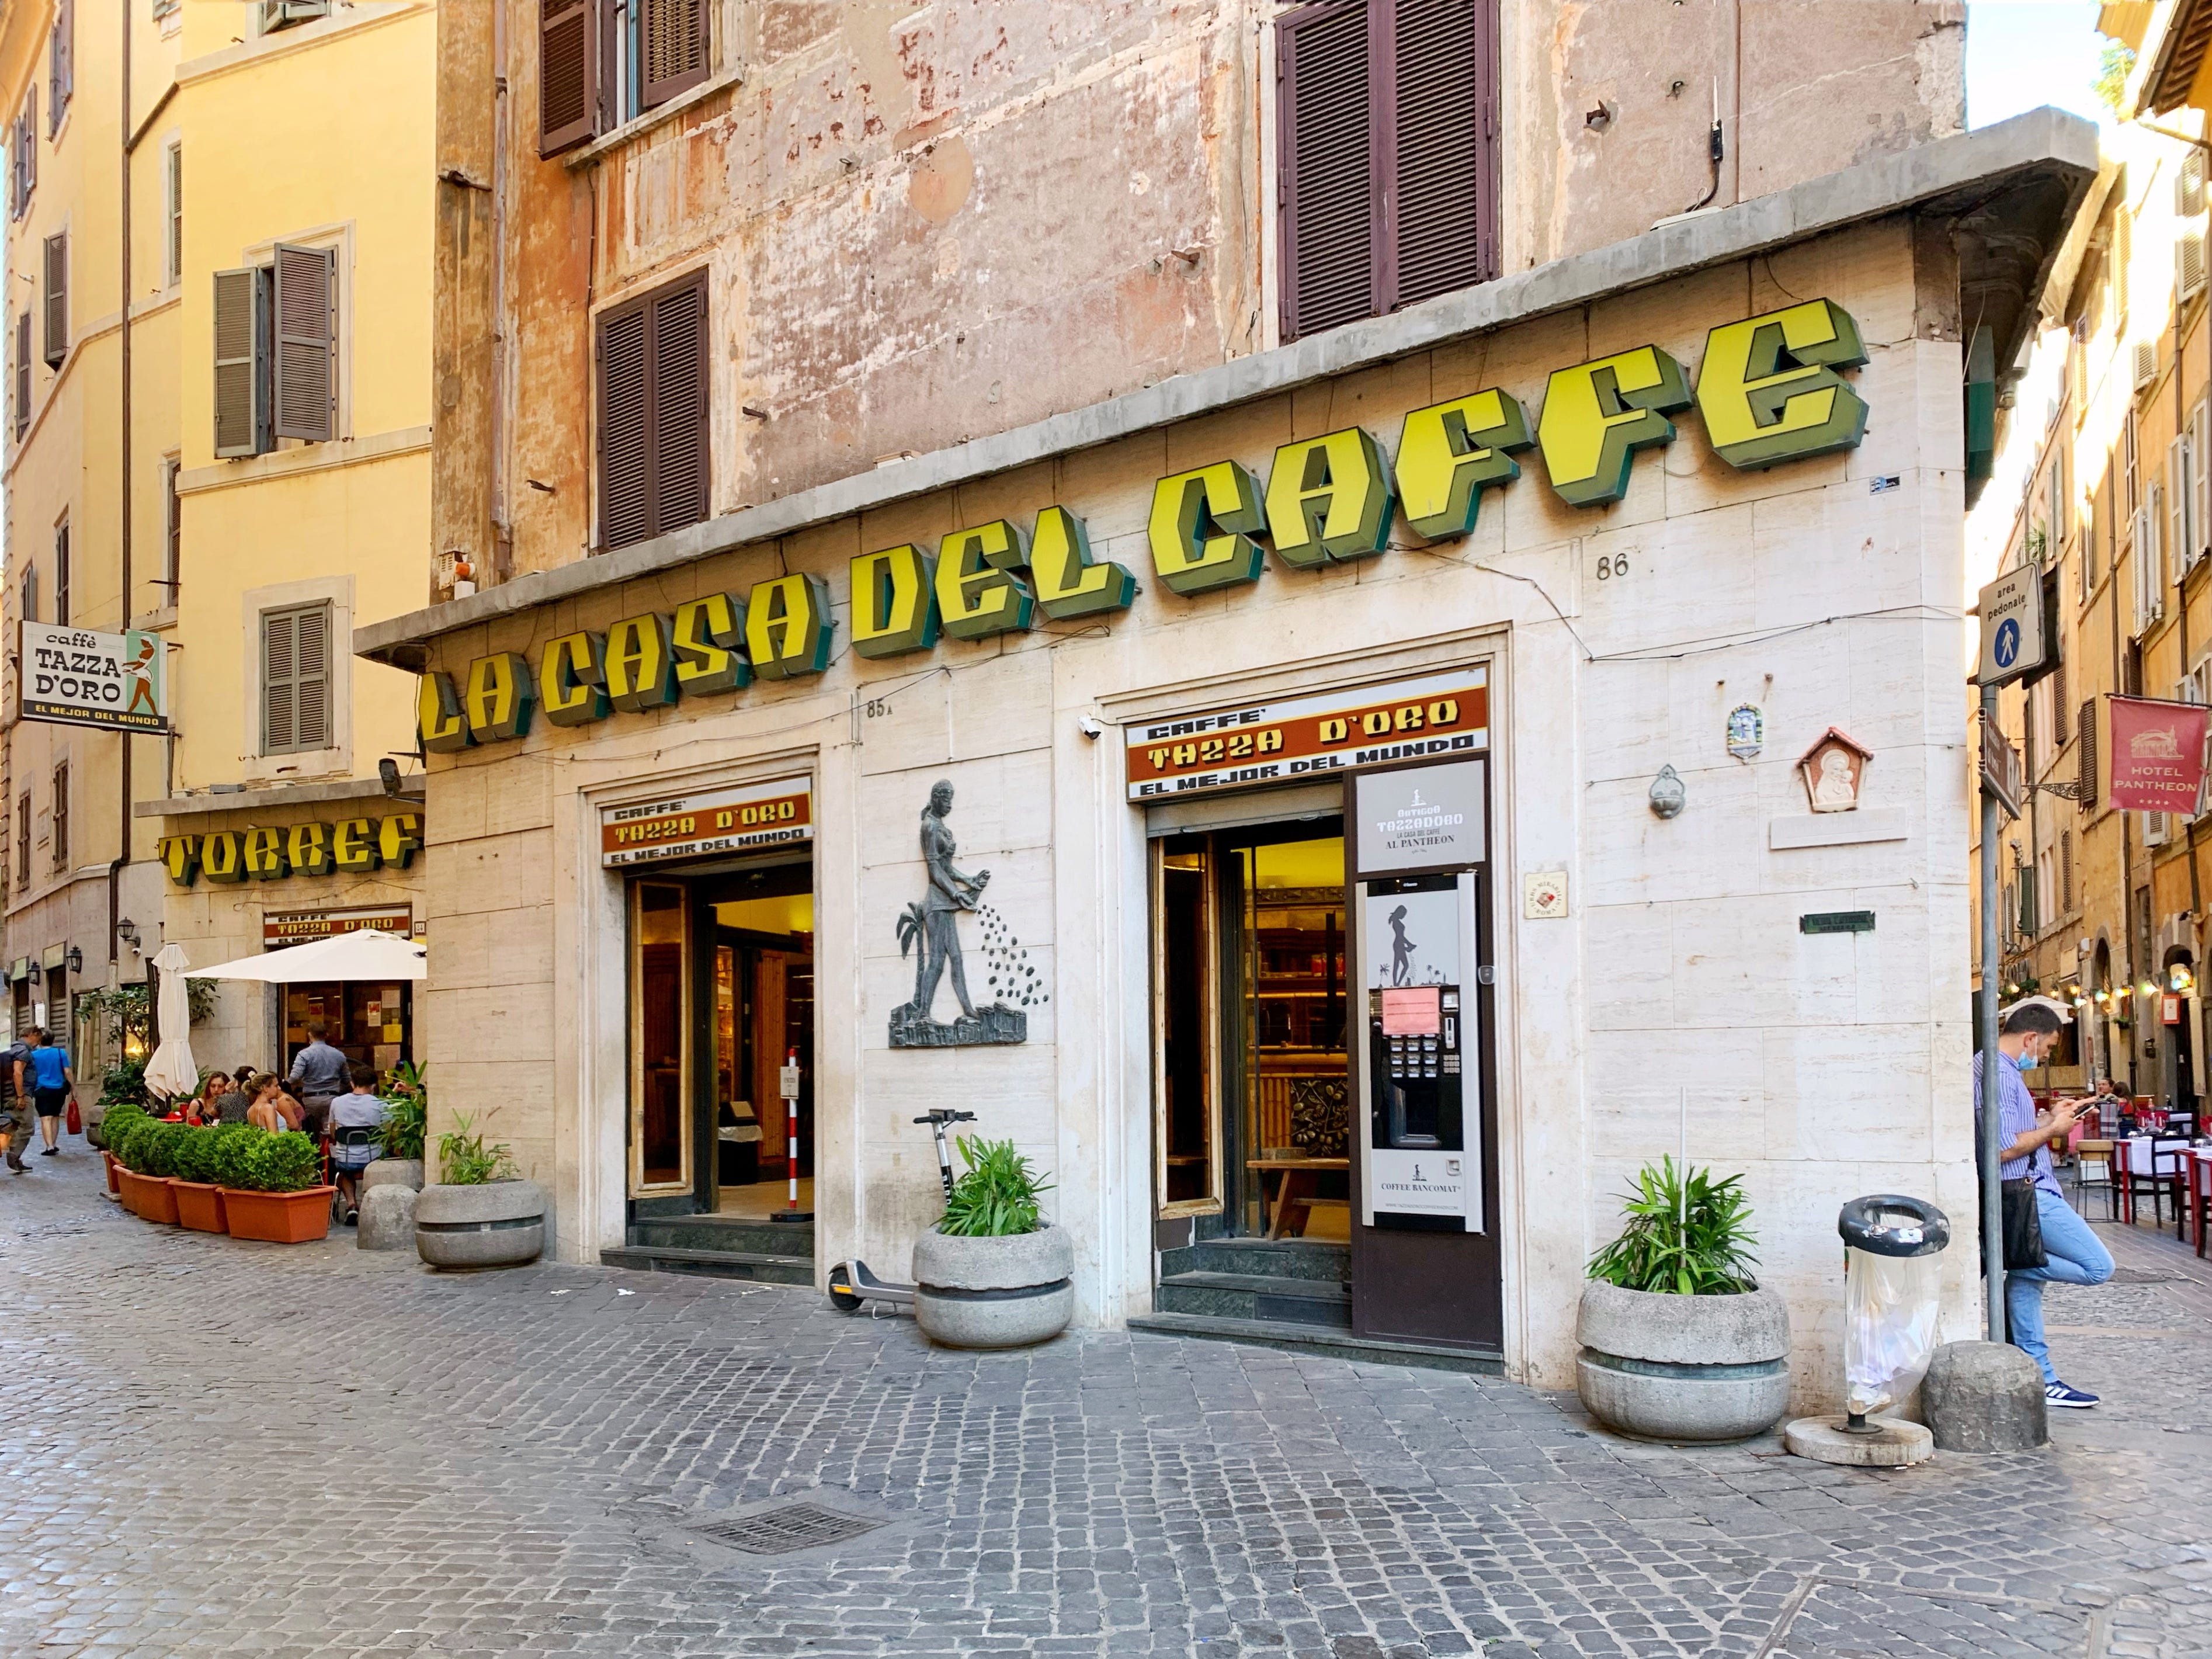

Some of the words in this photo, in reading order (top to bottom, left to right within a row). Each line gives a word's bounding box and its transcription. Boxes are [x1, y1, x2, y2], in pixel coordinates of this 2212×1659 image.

[418, 651, 523, 747] LA
[540, 572, 821, 721] CASA
[850, 505, 1124, 651] DEL
[1148, 297, 1855, 587] CAFFE
[1596, 553, 1628, 580] 86
[1997, 583, 2016, 599] area
[1988, 594, 2026, 622] pedonale
[46, 633, 96, 648] caffè
[36, 648, 121, 678] TAZZA
[36, 674, 120, 702] D'ORO
[35, 704, 47, 713] EL
[50, 706, 90, 717] MEJOR
[95, 712, 114, 721] DEL
[119, 714, 159, 726] MUNDO
[1148, 728, 1283, 769] TAZZA
[1319, 699, 1459, 742] D'ORO
[1140, 782, 1169, 796] EL
[1177, 765, 1279, 791] MEJOR
[1290, 755, 1345, 773] DEL
[1356, 734, 1474, 763] MUNDO
[2131, 766, 2183, 776] HOTEL
[2114, 780, 2197, 792] PANTHEON
[616, 817, 695, 843] TAZZA
[716, 801, 795, 828] D'ORO
[158, 813, 422, 881] TORREF
[610, 853, 630, 864] EL
[634, 844, 697, 860] MEJOR
[702, 839, 734, 852] DEL
[738, 828, 804, 846] MUNDO
[1401, 835, 1455, 848] PANTHEON
[277, 922, 331, 935] TAZZA
[1381, 1182, 1411, 1191] COFFEE
